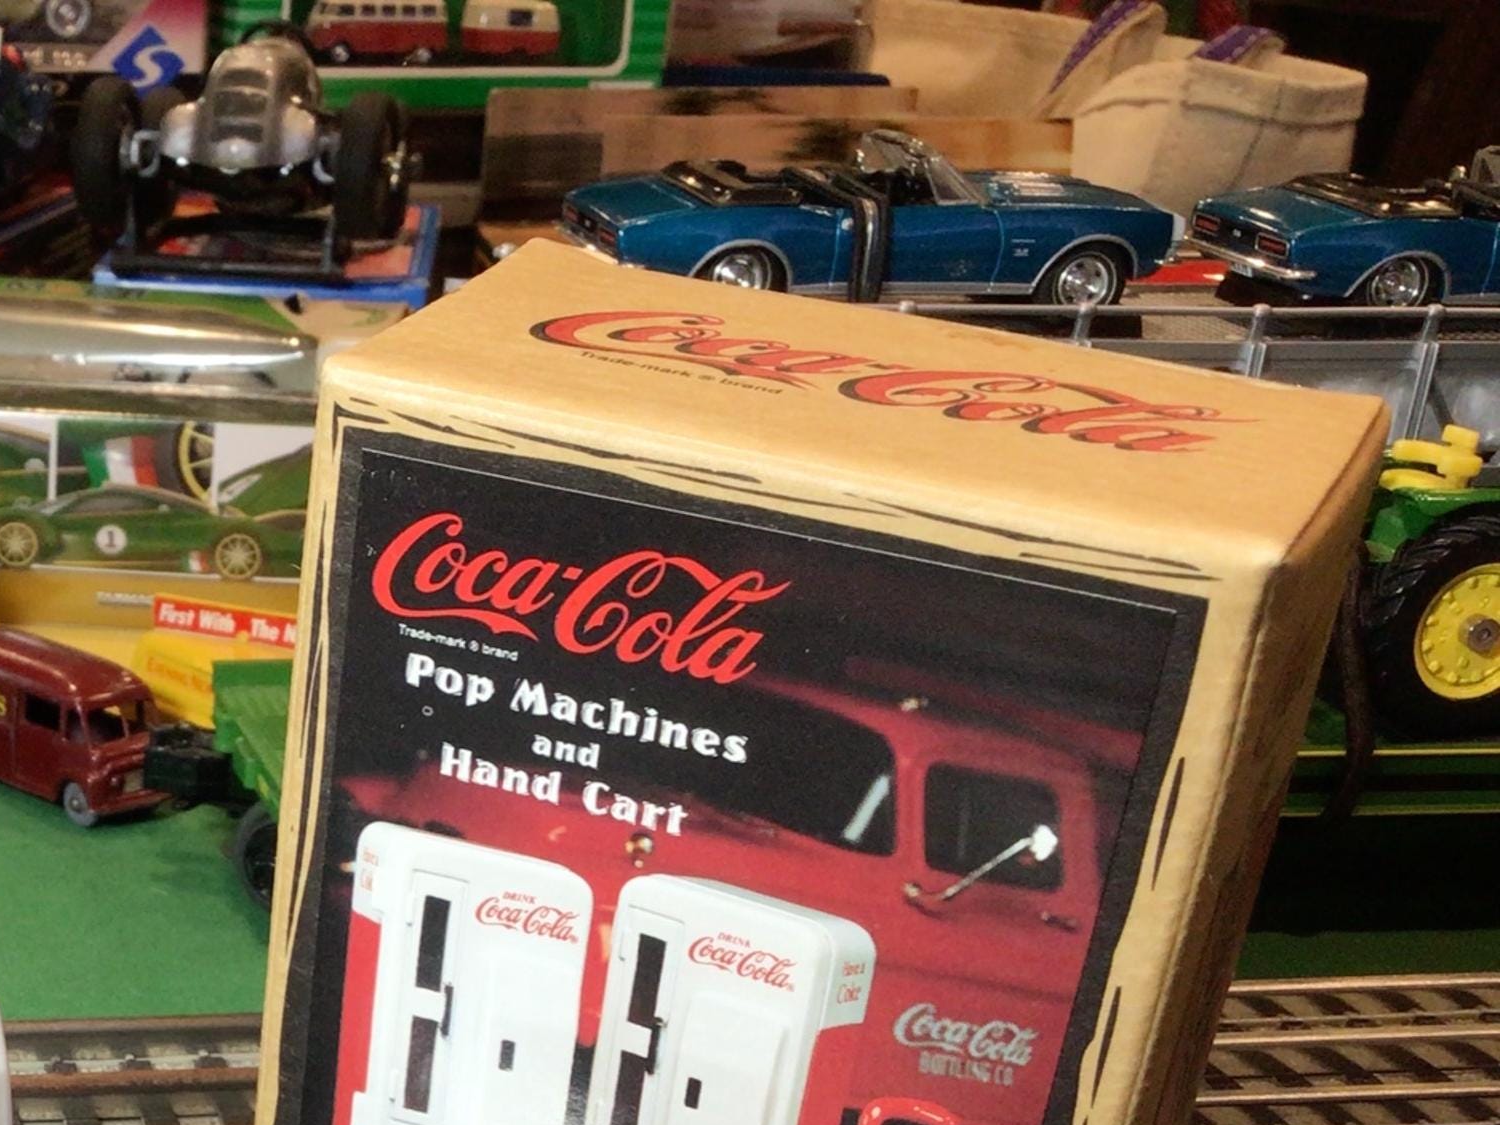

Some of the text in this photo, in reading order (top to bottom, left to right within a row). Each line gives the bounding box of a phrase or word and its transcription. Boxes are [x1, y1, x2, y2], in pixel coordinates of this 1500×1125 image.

[529, 310, 1264, 453] Coca-Cola
[581, 350, 692, 378] Trade-mark
[719, 377, 784, 395] brand
[158, 602, 196, 627] First
[200, 608, 237, 635] With
[251, 618, 281, 643] The
[372, 512, 792, 685] Coca-Cola
[398, 623, 467, 651] Trade-mark
[482, 643, 519, 662] brand
[404, 651, 750, 765] Pop Machines
[531, 733, 601, 770] and
[439, 741, 690, 838] Hand Cart
[475, 896, 581, 944] Coca-Cola
[502, 890, 537, 905] DRINK
[687, 935, 797, 993] Coca-Cola
[717, 931, 751, 949] DRINK
[893, 1002, 1040, 1067] Coca-Cola
